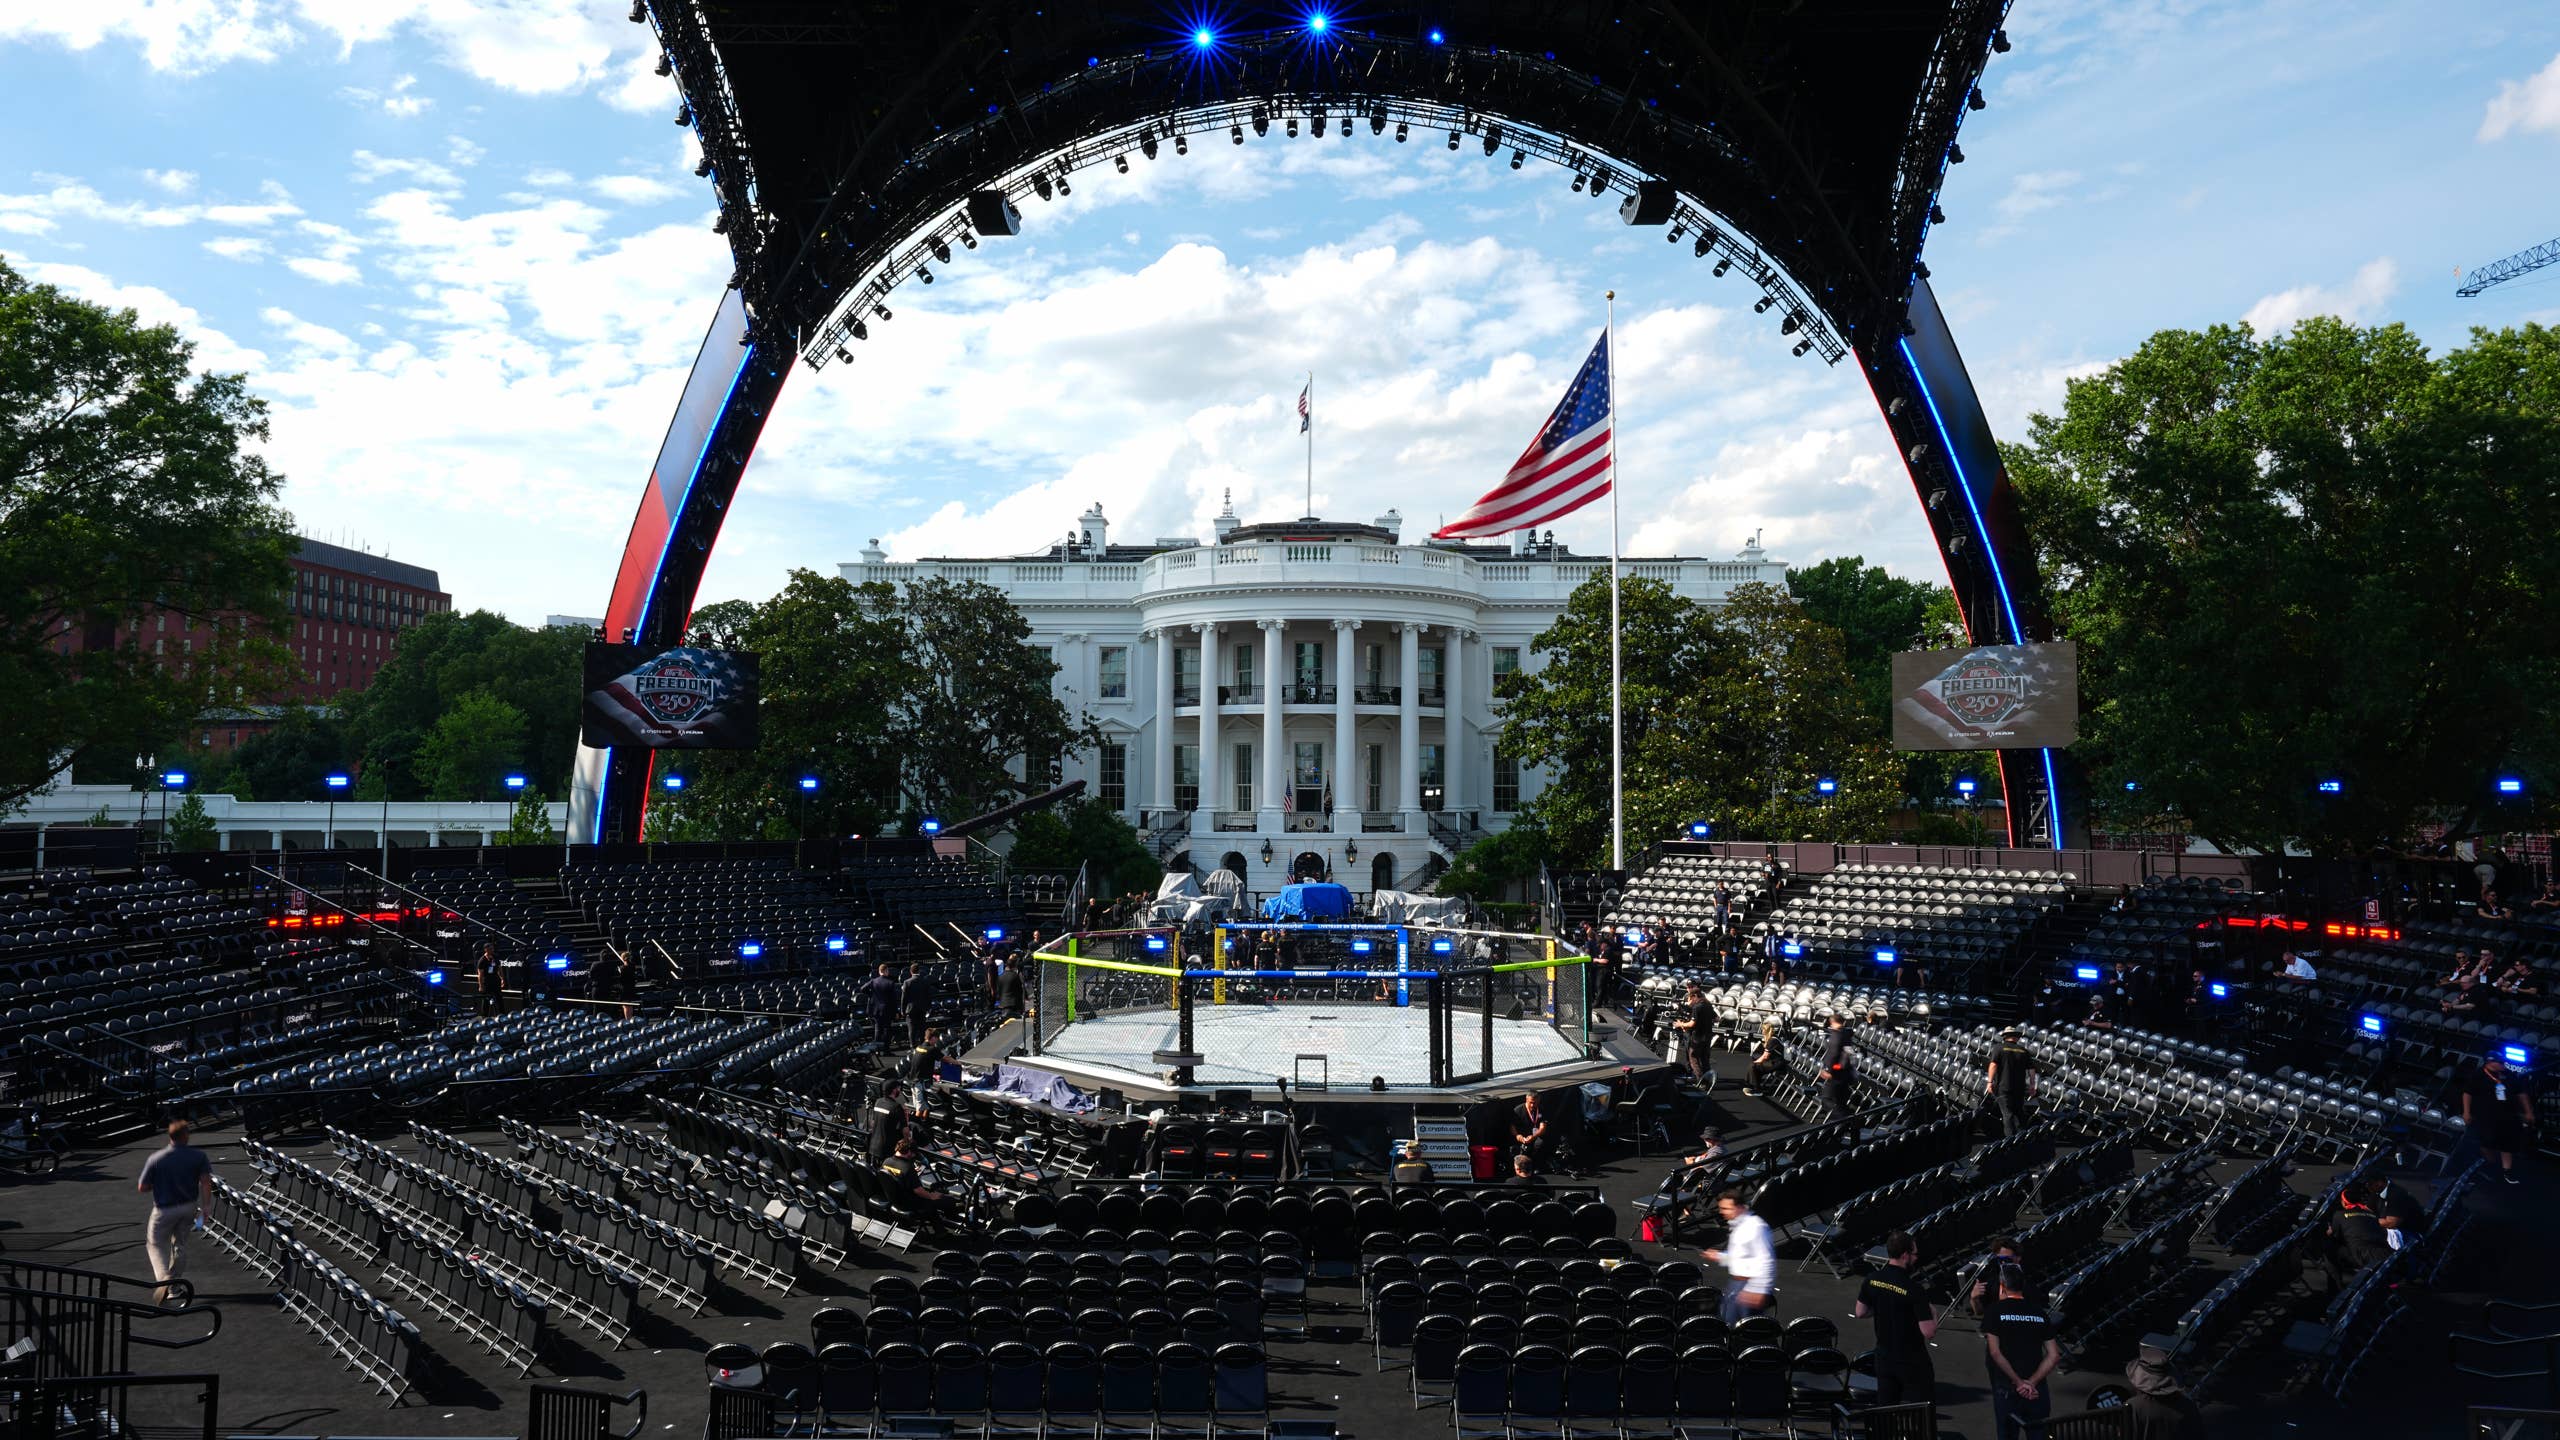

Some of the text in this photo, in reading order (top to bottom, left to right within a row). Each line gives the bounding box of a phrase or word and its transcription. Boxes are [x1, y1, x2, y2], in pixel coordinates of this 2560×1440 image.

[636, 677, 710, 697] FREEDOM
[1941, 678, 2021, 698] FREEDOM
[659, 694, 691, 710] 250
[1966, 695, 1999, 712] 250
[1399, 943, 1407, 992] BUD LIHT
[1870, 1280, 1908, 1296] PRODUCTION
